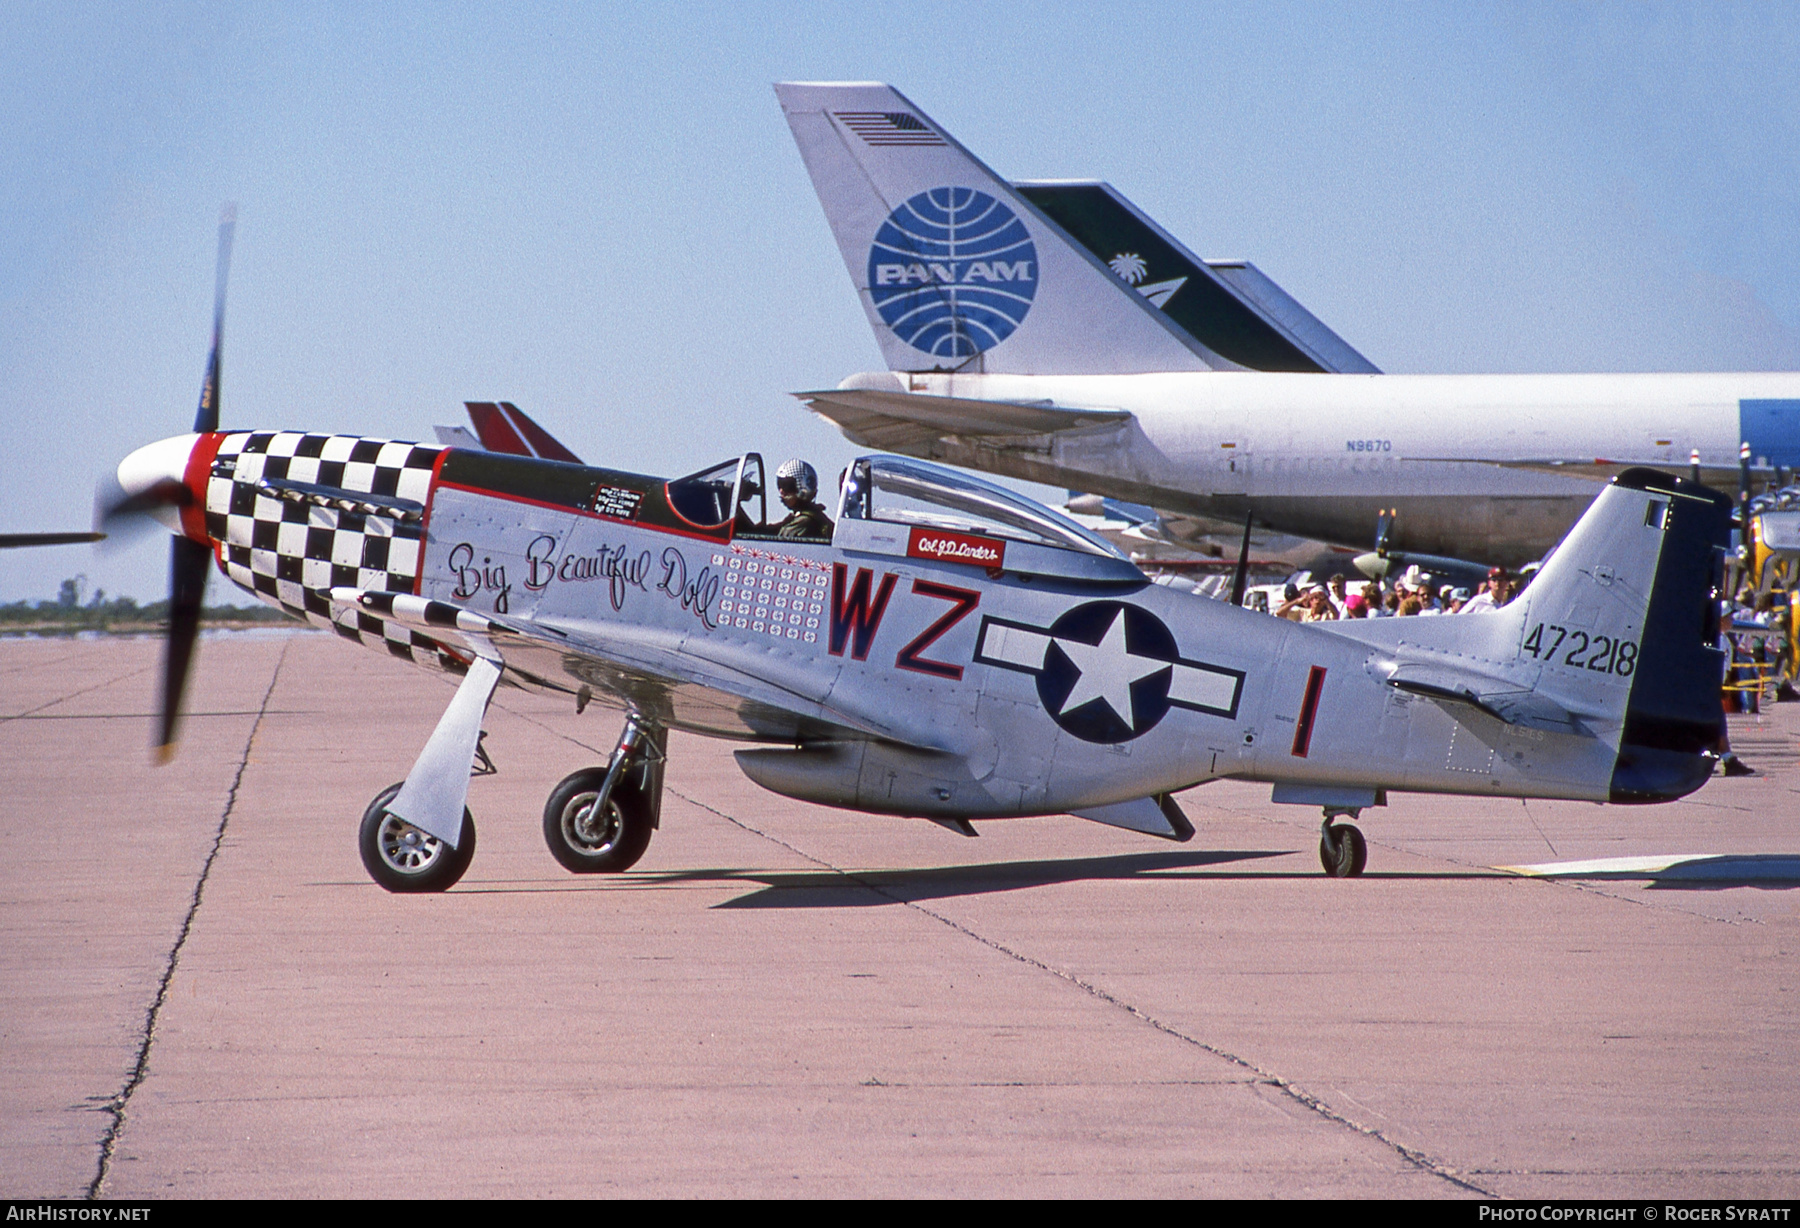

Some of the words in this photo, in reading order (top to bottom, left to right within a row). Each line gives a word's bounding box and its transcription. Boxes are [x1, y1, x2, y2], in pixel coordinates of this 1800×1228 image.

[876, 262, 959, 285] PAN
[962, 260, 1034, 283] AM
[1346, 439, 1392, 452] N9670
[449, 542, 511, 614] Big
[524, 535, 650, 612] Beautiful
[657, 546, 719, 631] Doll
[1523, 622, 1638, 677] 472218
